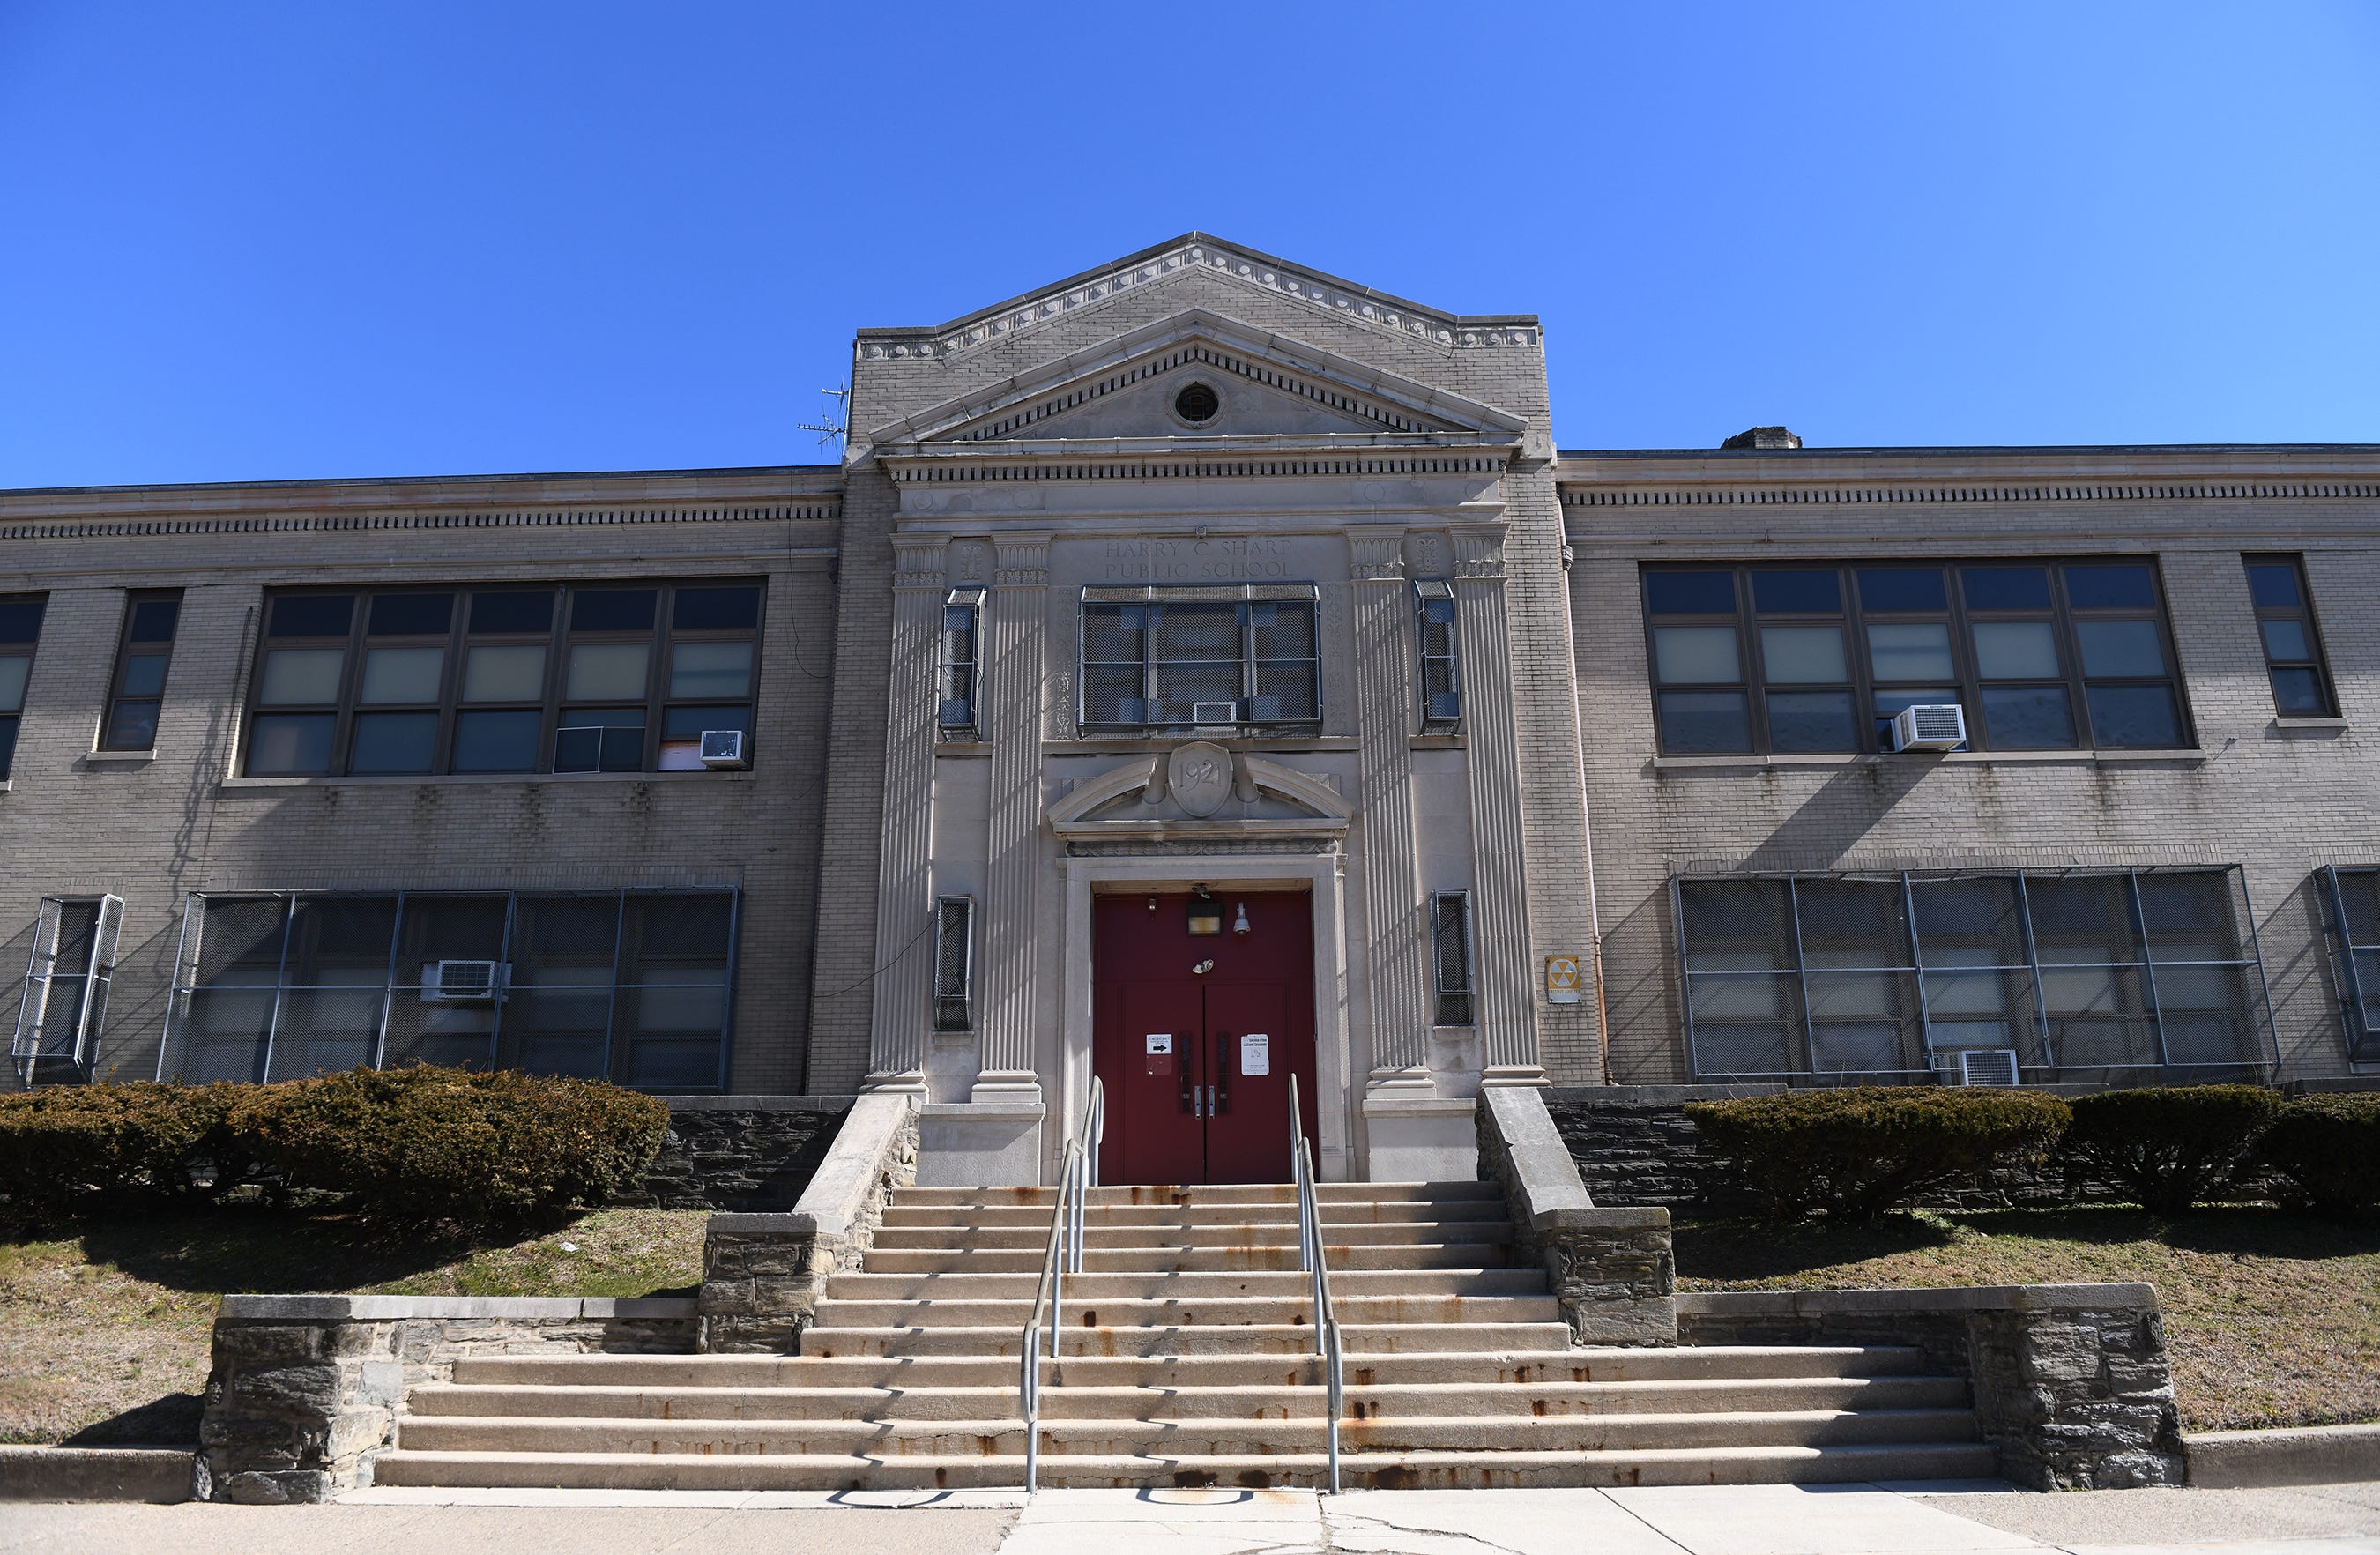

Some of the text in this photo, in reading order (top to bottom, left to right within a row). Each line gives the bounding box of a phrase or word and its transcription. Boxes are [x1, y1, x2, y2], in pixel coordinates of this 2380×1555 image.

[1105, 541, 1181, 558] HARRY
[1221, 539, 1292, 556] SHARP
[1104, 562, 1294, 578] PUBLIC SCHOOL
[1179, 759, 1222, 792] 1921
